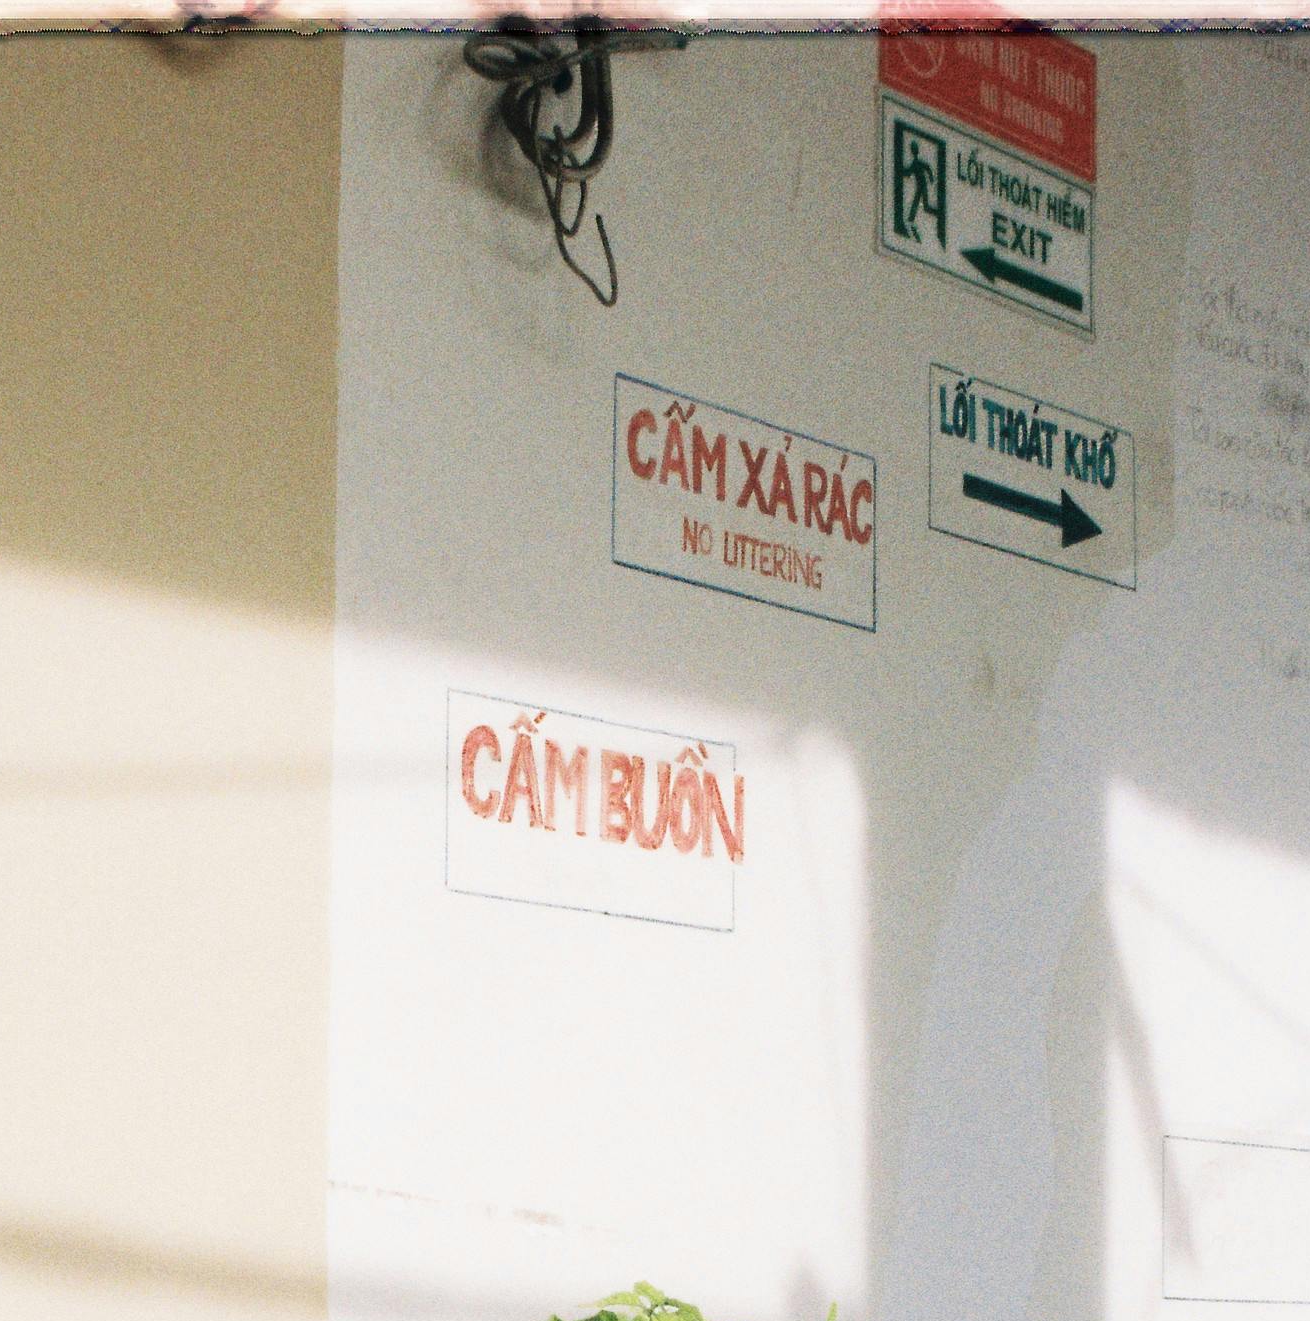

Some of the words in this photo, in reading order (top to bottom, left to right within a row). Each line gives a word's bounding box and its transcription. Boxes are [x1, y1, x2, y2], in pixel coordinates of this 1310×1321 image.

[957, 147, 984, 189] LỐI
[988, 165, 1042, 214] THOÁT
[992, 210, 1053, 263] EXIT
[940, 377, 977, 443] LỐI
[982, 398, 1058, 469] THOÁT
[627, 400, 727, 501] CẤM
[736, 434, 798, 525] XẢ
[803, 454, 873, 545] RÁC
[681, 515, 713, 555] NO
[461, 711, 590, 836] CẤM
[599, 742, 745, 865] BUỒN
